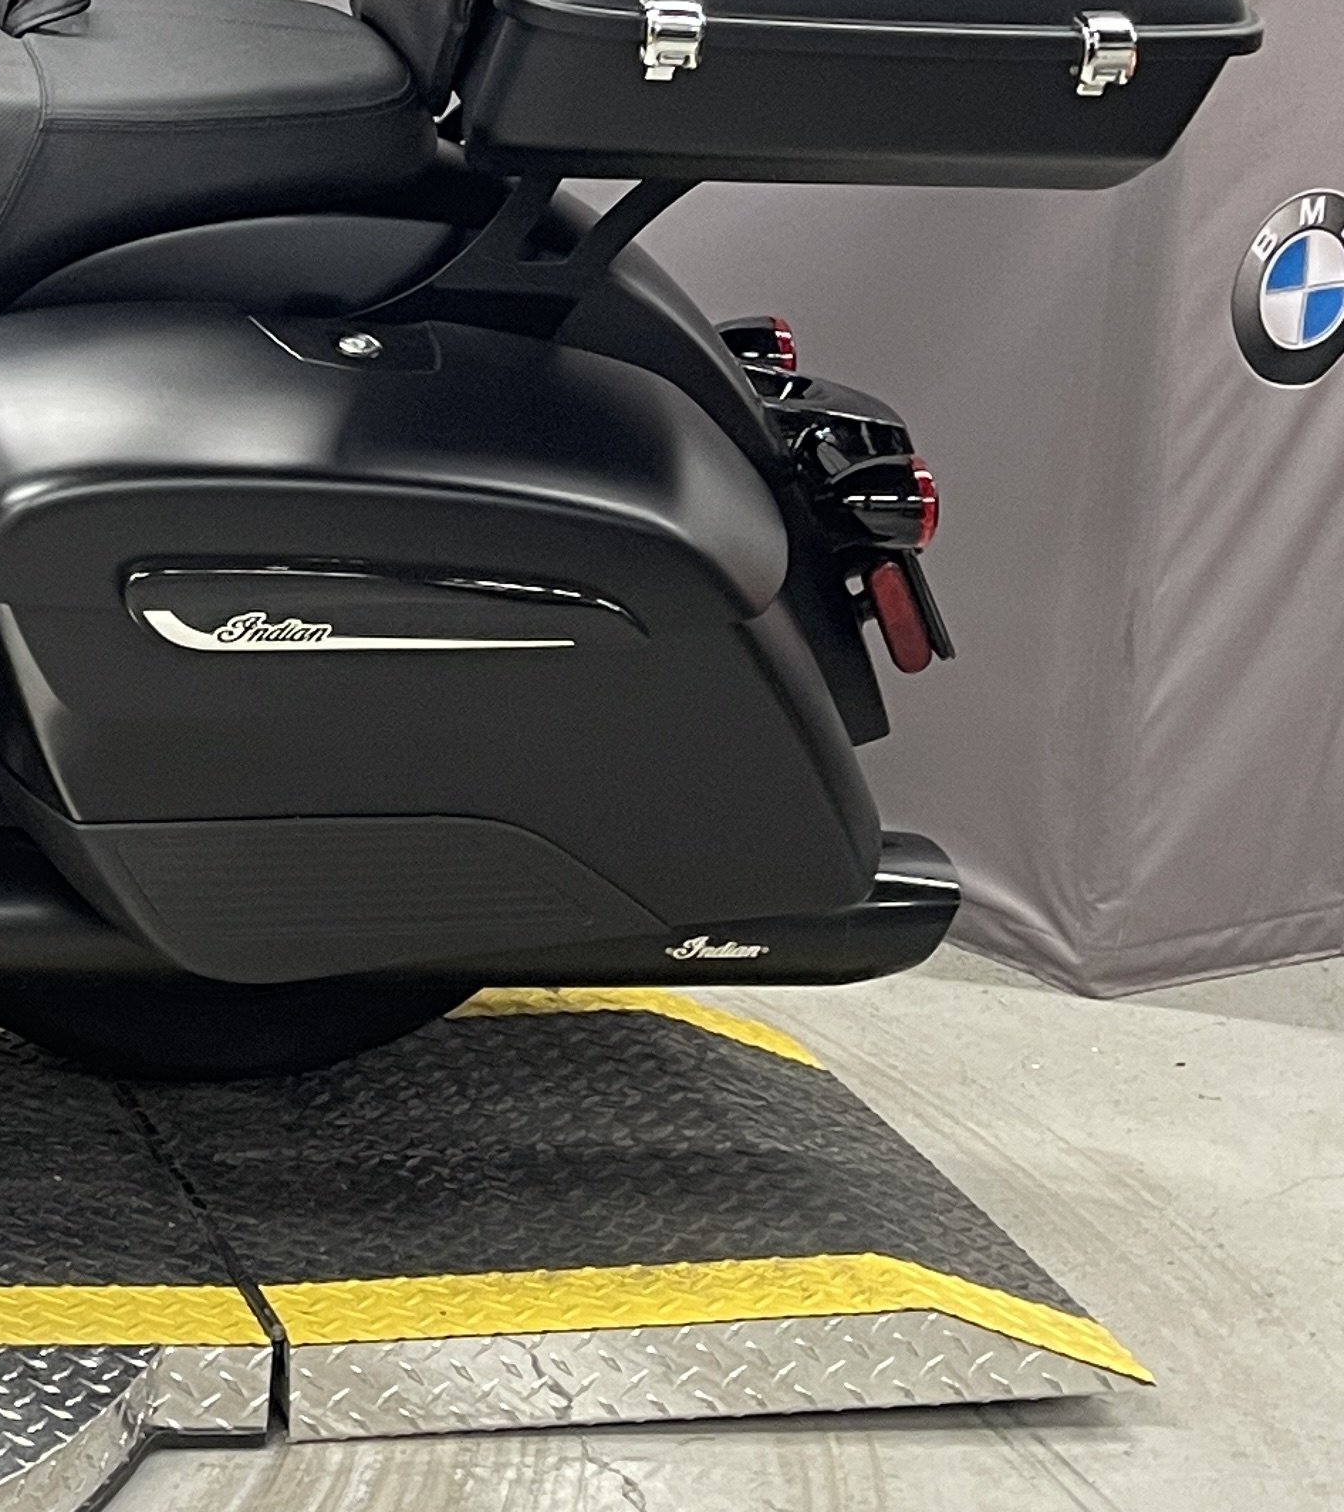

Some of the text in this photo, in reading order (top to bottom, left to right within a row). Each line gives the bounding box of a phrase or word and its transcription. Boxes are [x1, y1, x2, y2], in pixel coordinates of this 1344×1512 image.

[1252, 195, 1344, 262] BM
[215, 613, 331, 645] Indian
[671, 935, 762, 961] Indian
